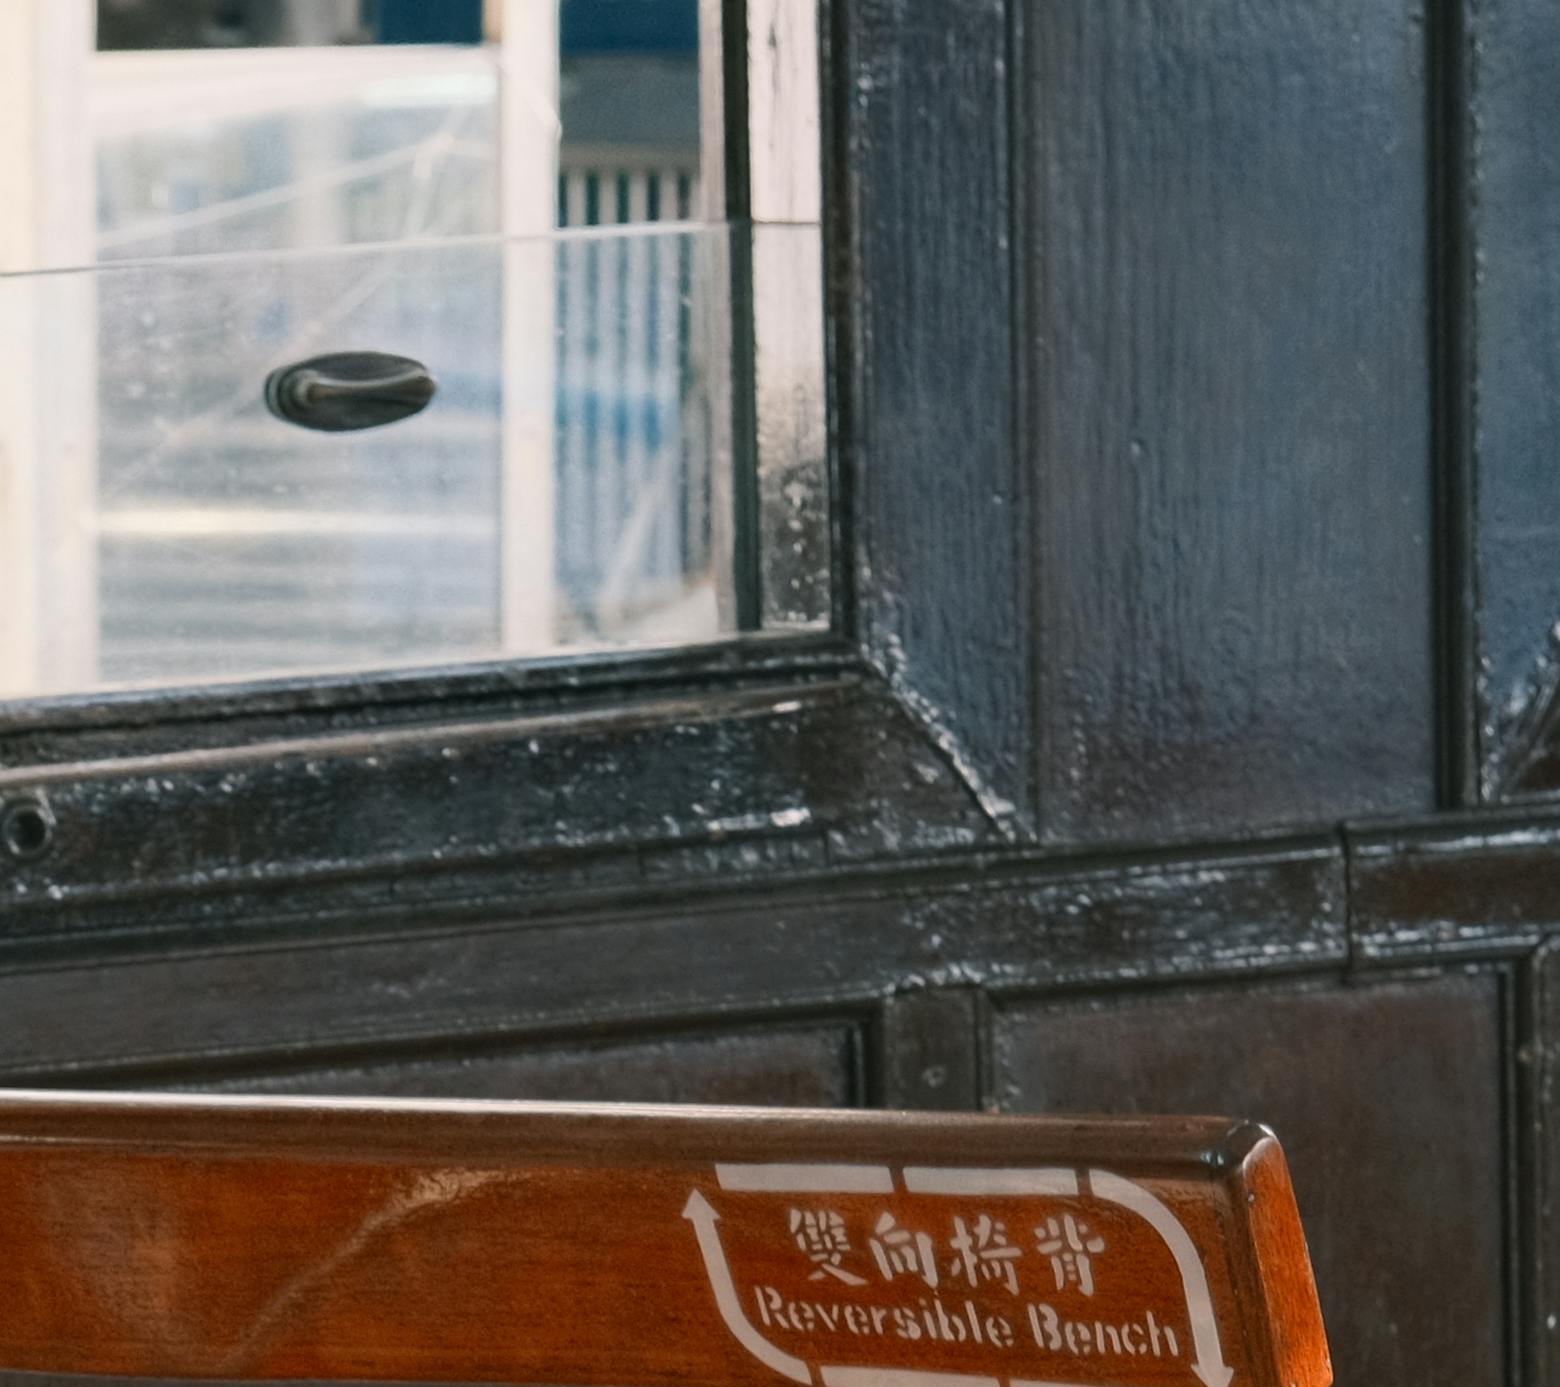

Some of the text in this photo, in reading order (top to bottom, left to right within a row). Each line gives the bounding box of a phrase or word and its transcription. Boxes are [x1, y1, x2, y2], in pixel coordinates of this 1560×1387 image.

[789, 1208, 1106, 1298] 雙向椅背
[755, 1286, 1179, 1359] Reversible Bench
